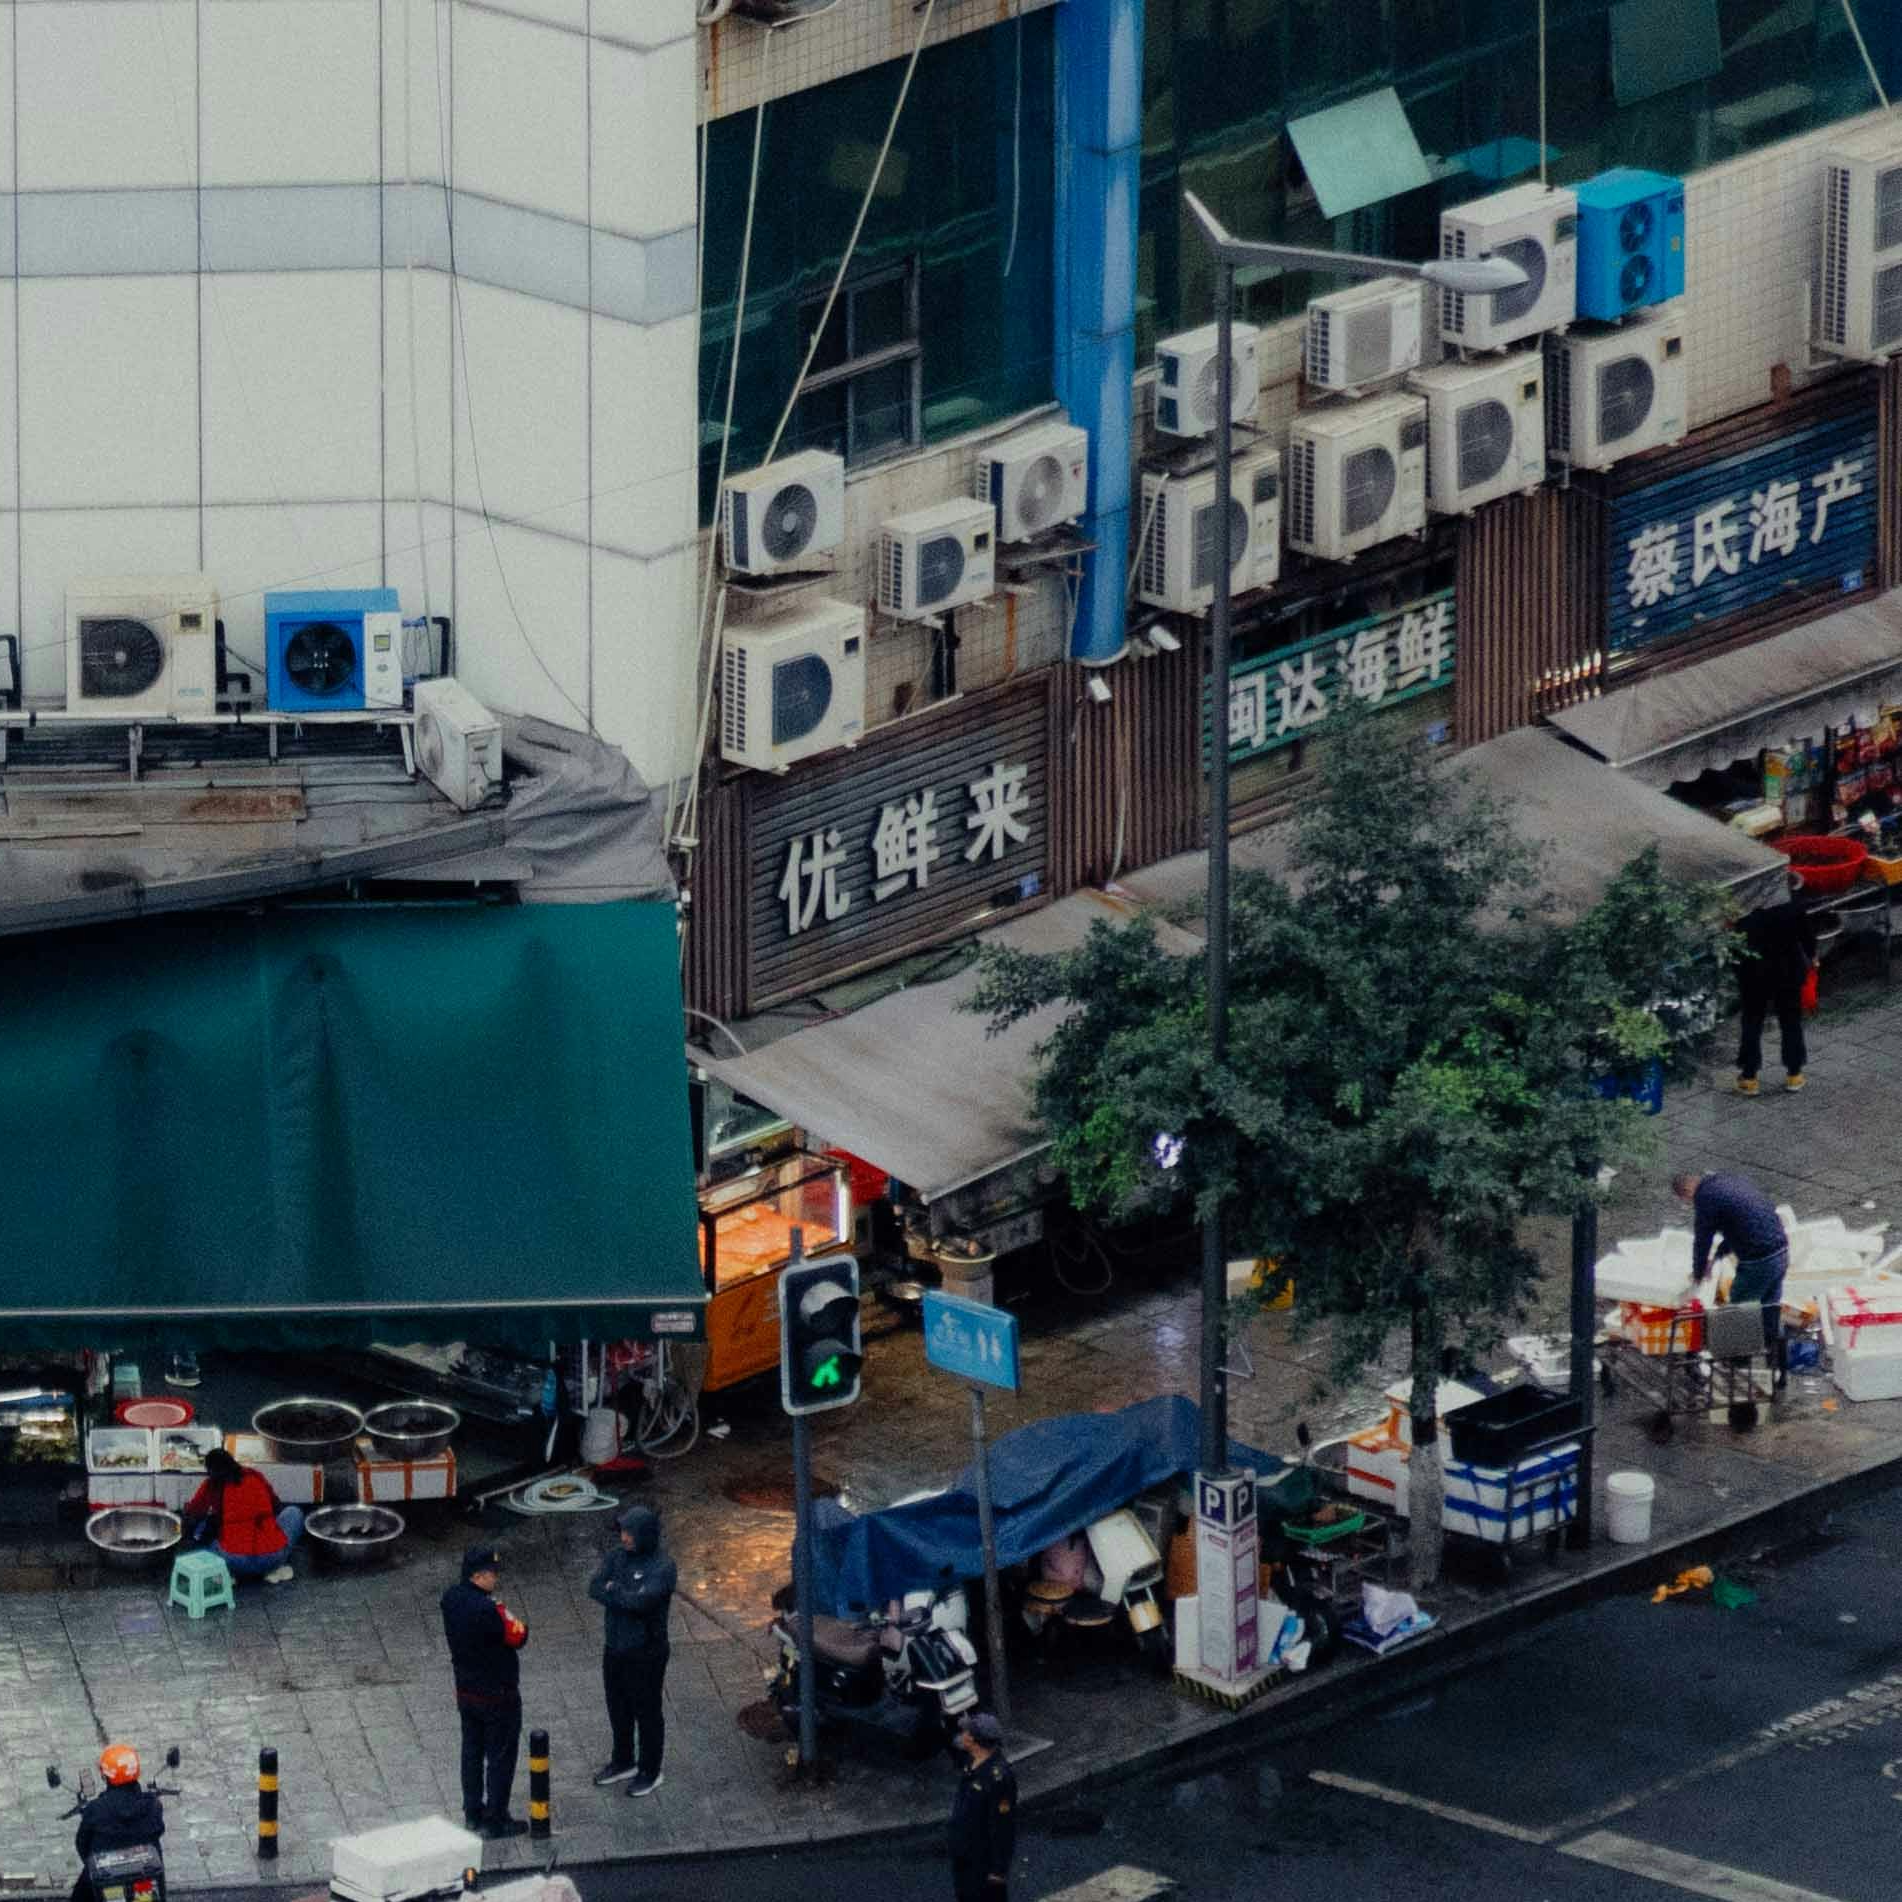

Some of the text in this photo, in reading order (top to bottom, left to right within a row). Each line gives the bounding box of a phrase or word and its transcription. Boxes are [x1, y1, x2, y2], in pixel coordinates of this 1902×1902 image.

[1628, 459, 1864, 607] 蔡氏海产
[778, 764, 1030, 935] 优鲜来
